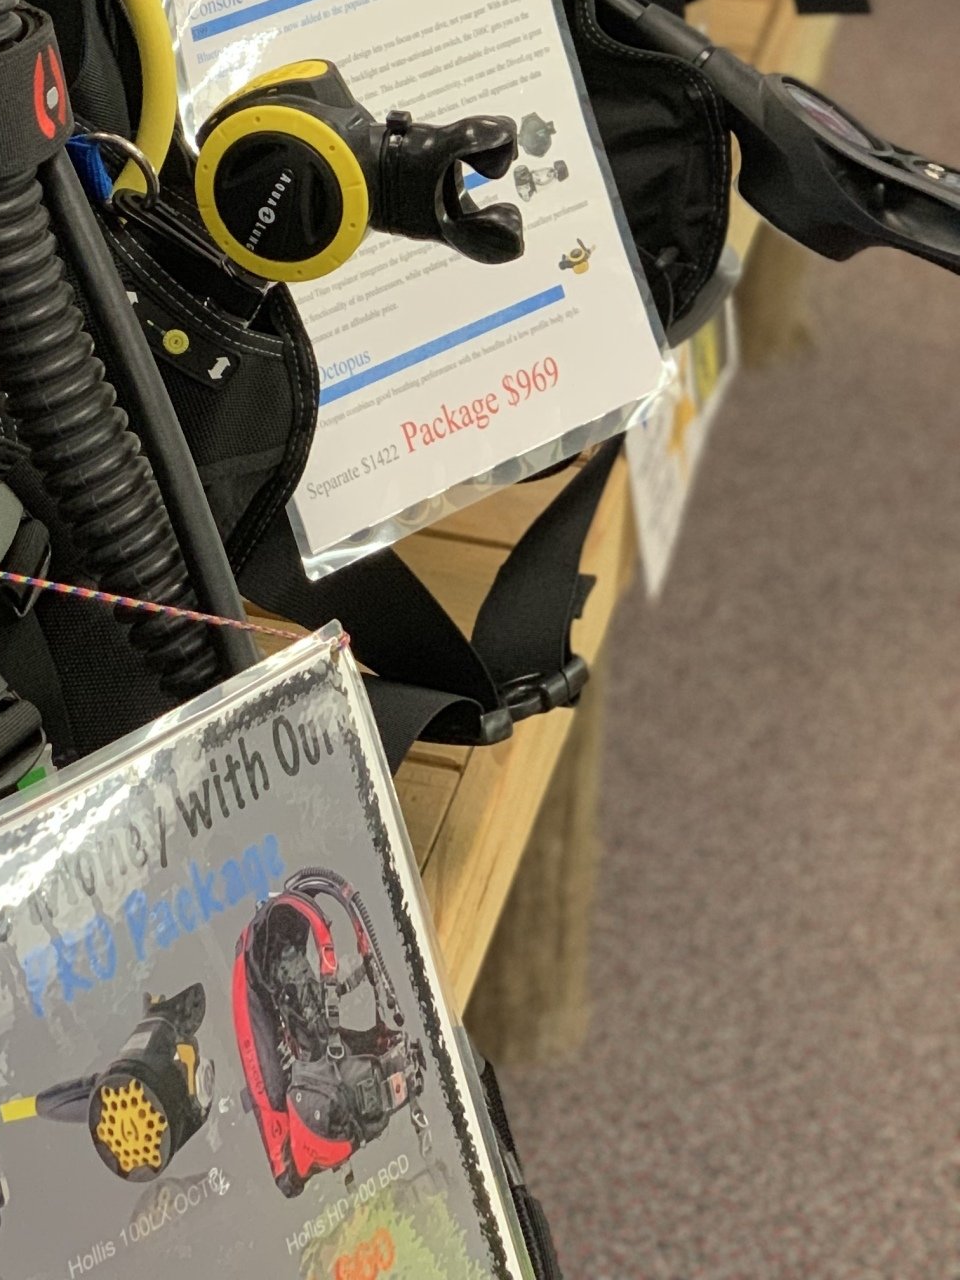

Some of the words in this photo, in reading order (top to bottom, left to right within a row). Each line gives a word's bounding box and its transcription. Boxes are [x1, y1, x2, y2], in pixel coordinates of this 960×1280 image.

[246, 221, 267, 251] LUNG
[266, 173, 292, 207] AQUA
[305, 468, 361, 501] Separate
[360, 444, 401, 476] $1422
[399, 391, 500, 454] Package
[501, 356, 560, 408] $969
[175, 736, 271, 838] with
[123, 834, 287, 963] Package
[67, 1240, 117, 1280] Hollis
[119, 1202, 172, 1248] 100LX
[285, 1216, 327, 1255] Hollis
[326, 1198, 349, 1227] HD
[377, 1153, 410, 1189] BCD
